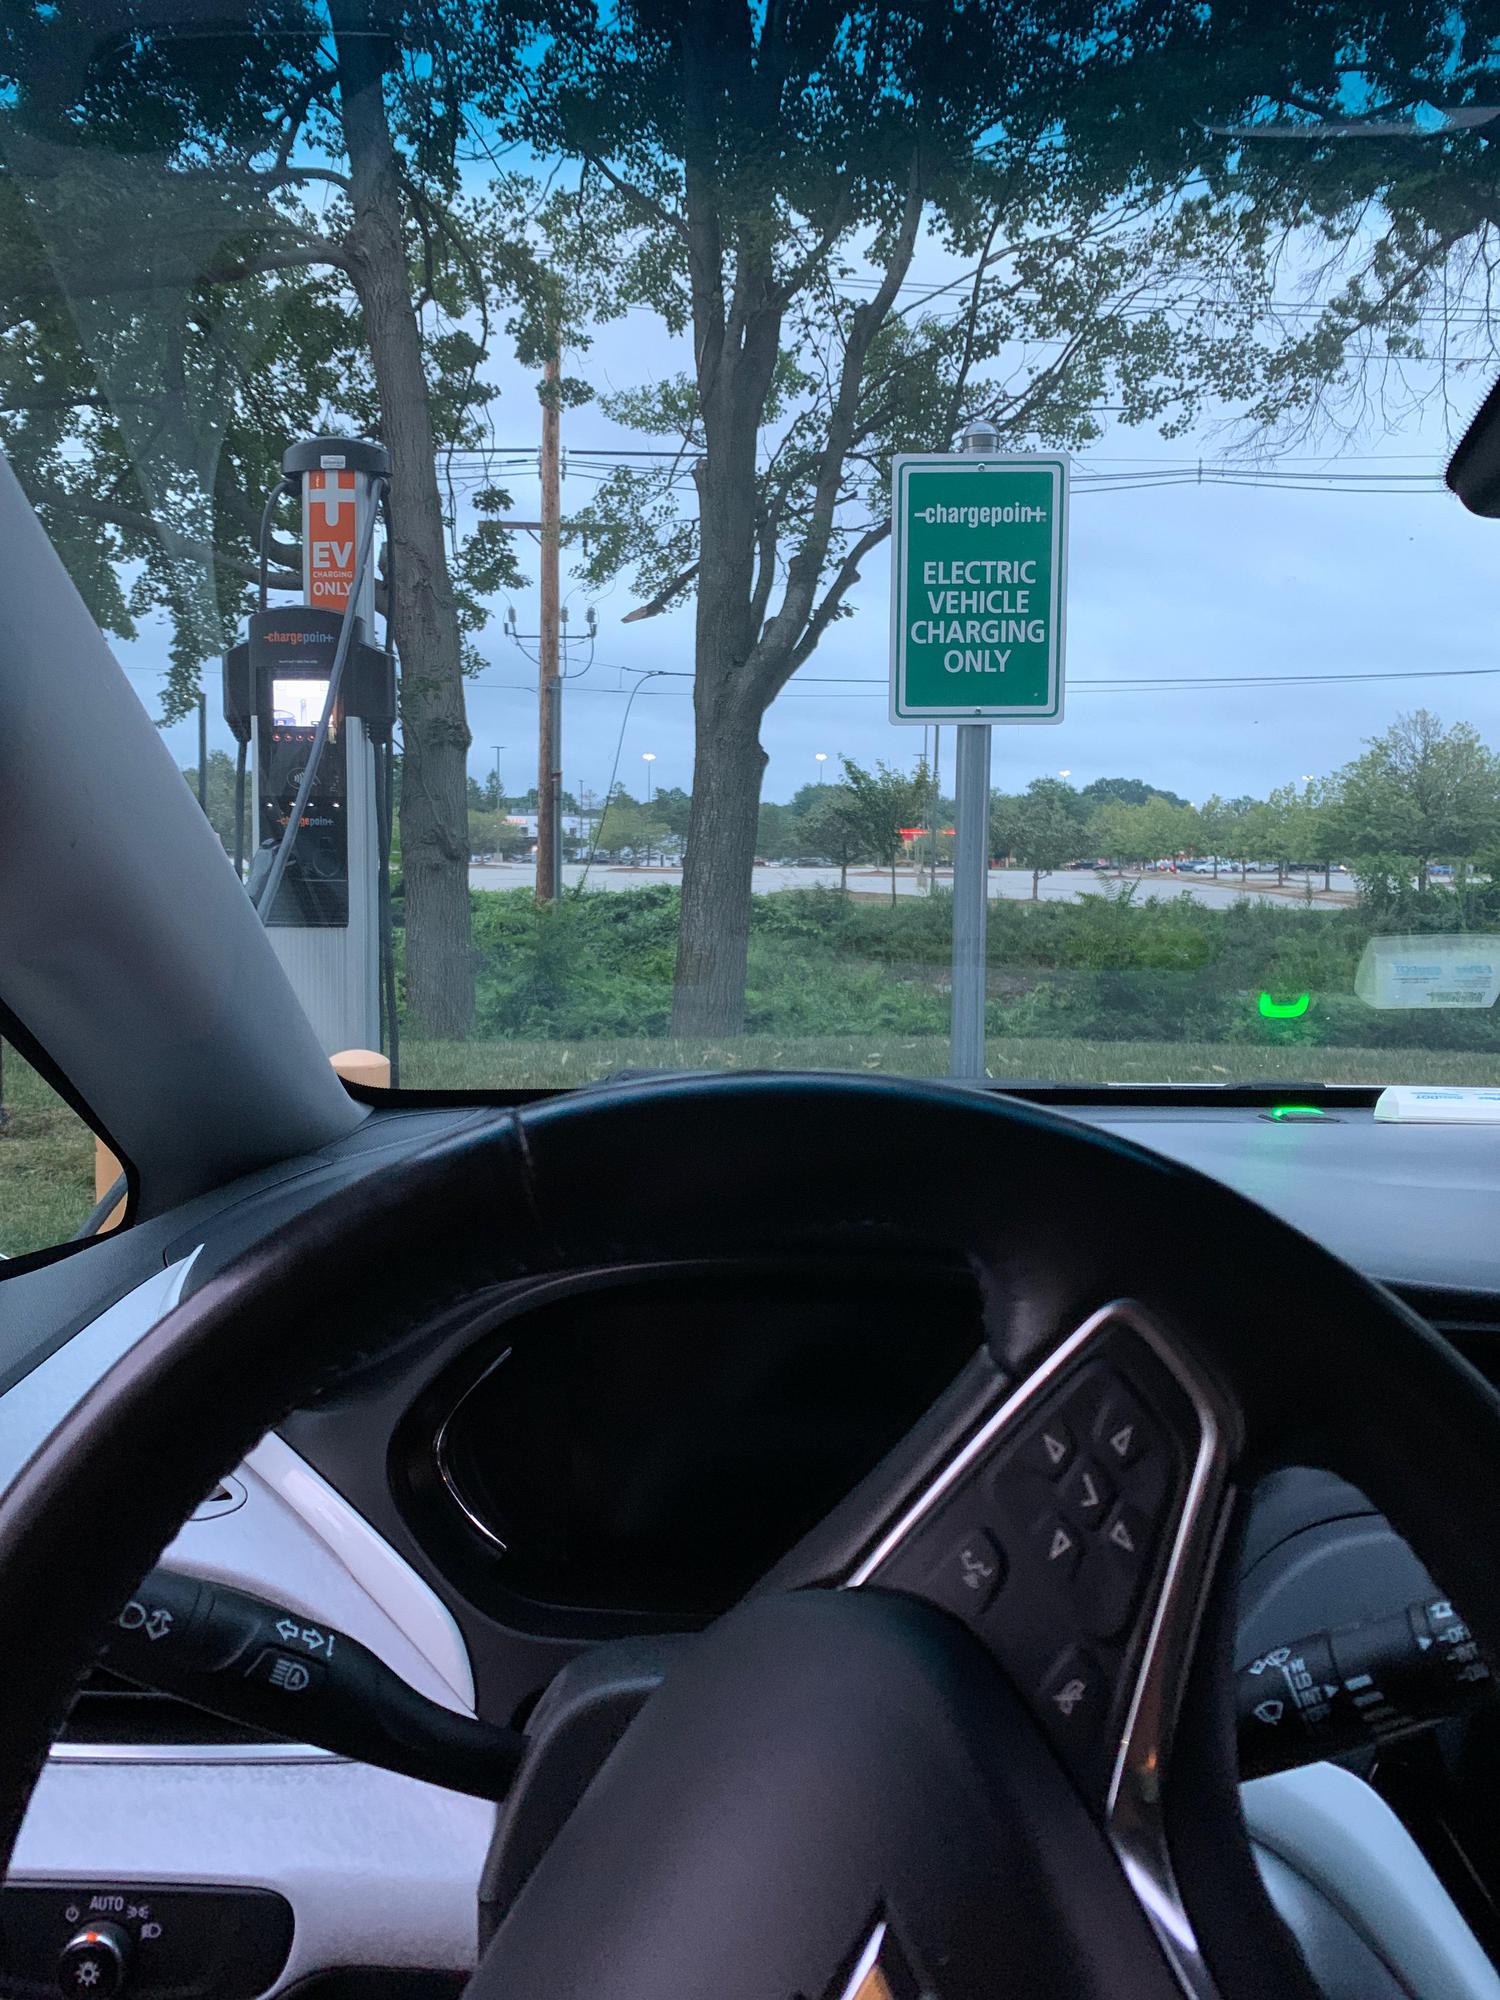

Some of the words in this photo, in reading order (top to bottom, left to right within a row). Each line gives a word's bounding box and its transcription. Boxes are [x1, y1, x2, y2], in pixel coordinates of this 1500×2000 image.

[313, 541, 353, 568] EV
[923, 561, 1036, 585] ELECTRIC
[313, 581, 353, 596] ONLY
[927, 590, 1029, 614] VEHICLE
[910, 620, 1045, 644] CHARGING
[944, 649, 1011, 673] ONLY
[89, 1895, 124, 1911] AUTO
